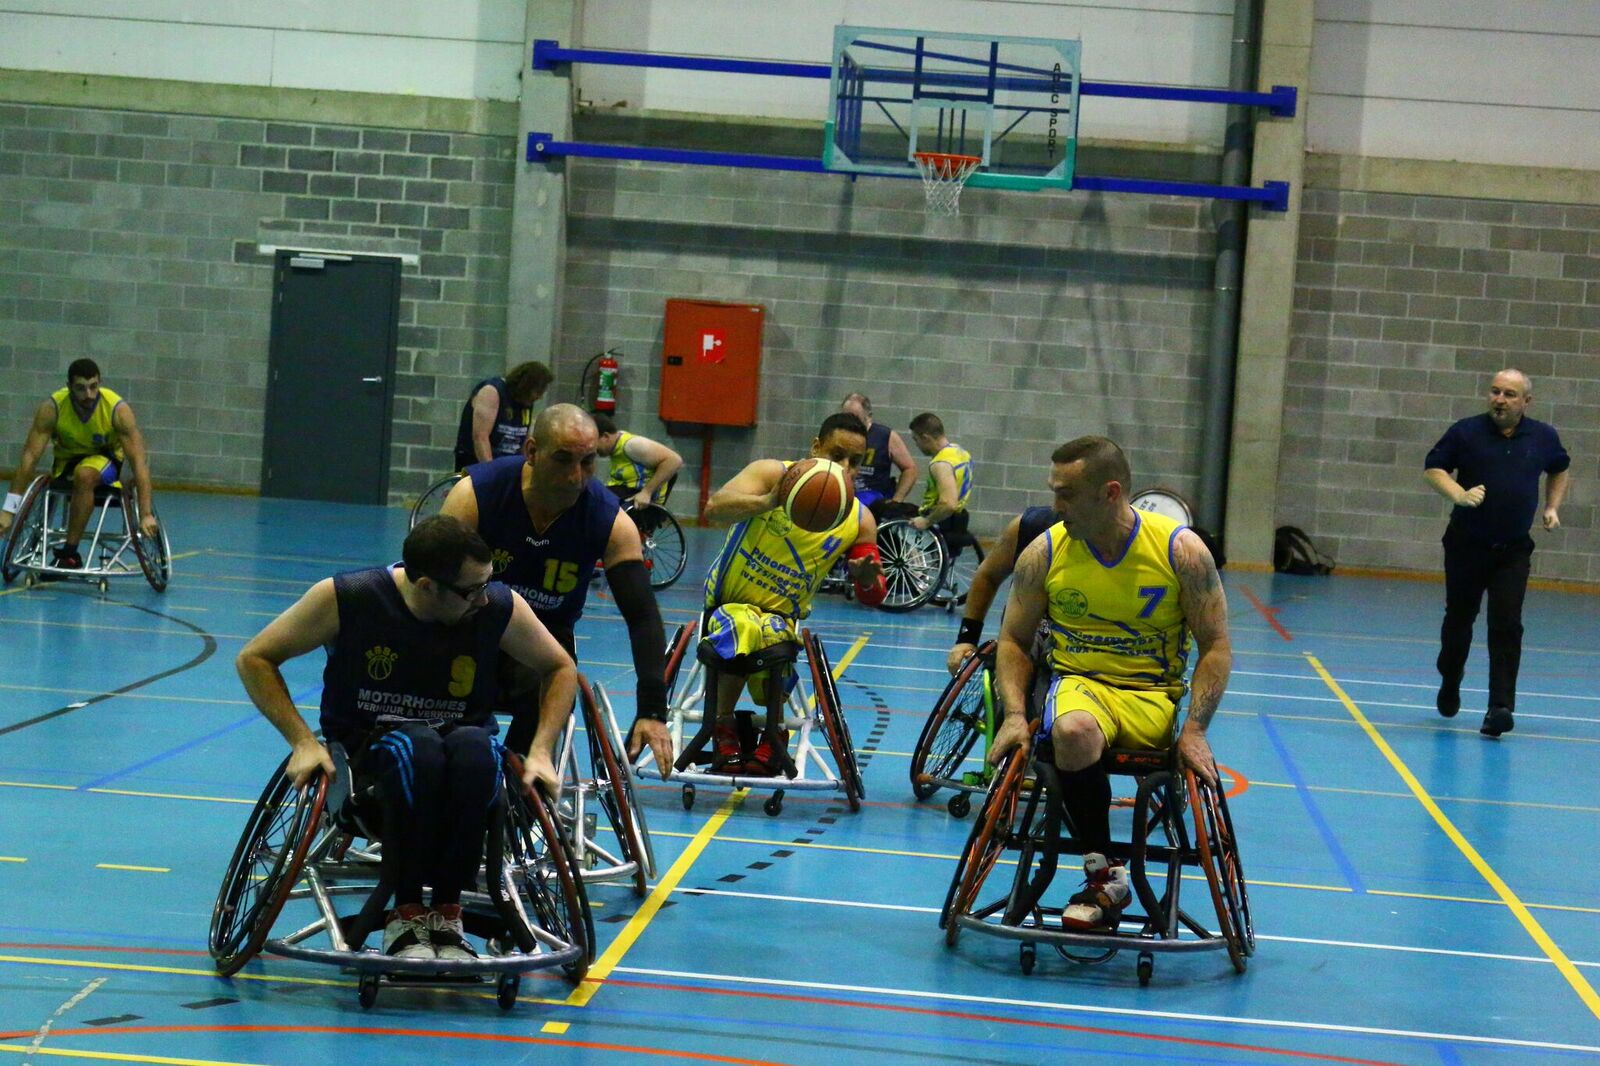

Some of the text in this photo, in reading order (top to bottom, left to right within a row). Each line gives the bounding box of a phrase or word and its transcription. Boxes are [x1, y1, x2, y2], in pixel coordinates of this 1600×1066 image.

[1048, 108, 1058, 159] SPORT
[820, 535, 843, 560] 4
[543, 558, 579, 594] 15
[1136, 586, 1168, 618] 7
[448, 655, 477, 697] 9
[358, 688, 467, 711] MOTORHOMES
